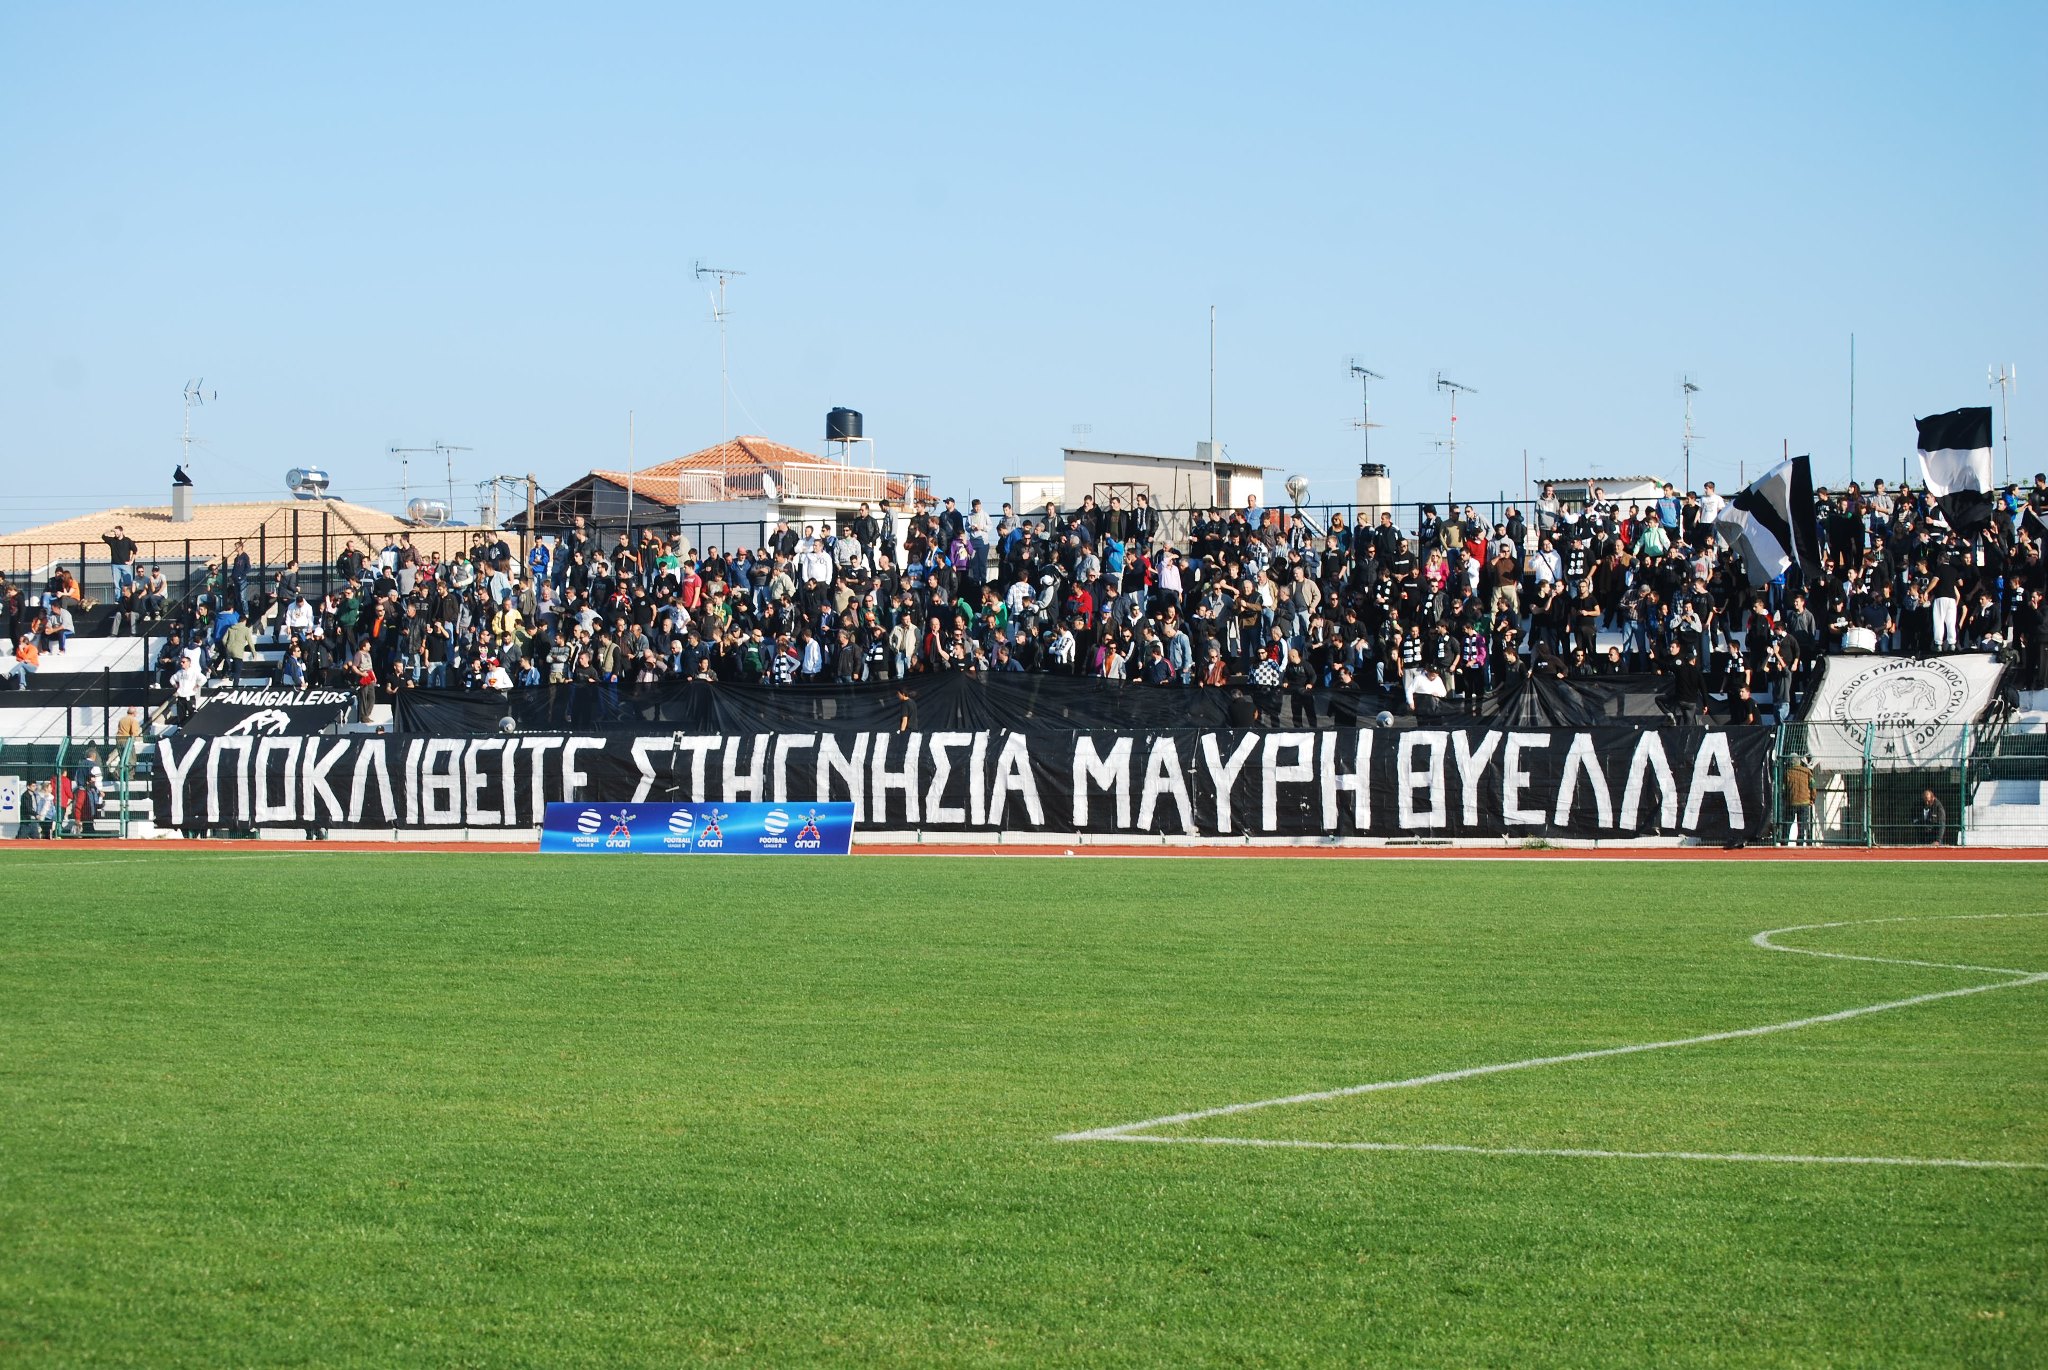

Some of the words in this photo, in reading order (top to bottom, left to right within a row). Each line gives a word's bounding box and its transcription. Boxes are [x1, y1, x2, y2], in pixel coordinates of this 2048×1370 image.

[210, 689, 349, 707] PANAIGIALEIOS
[1072, 731, 1374, 833] ΜΑΥΡΗ
[1397, 729, 1745, 830] ΘΥΕΛΛΑ
